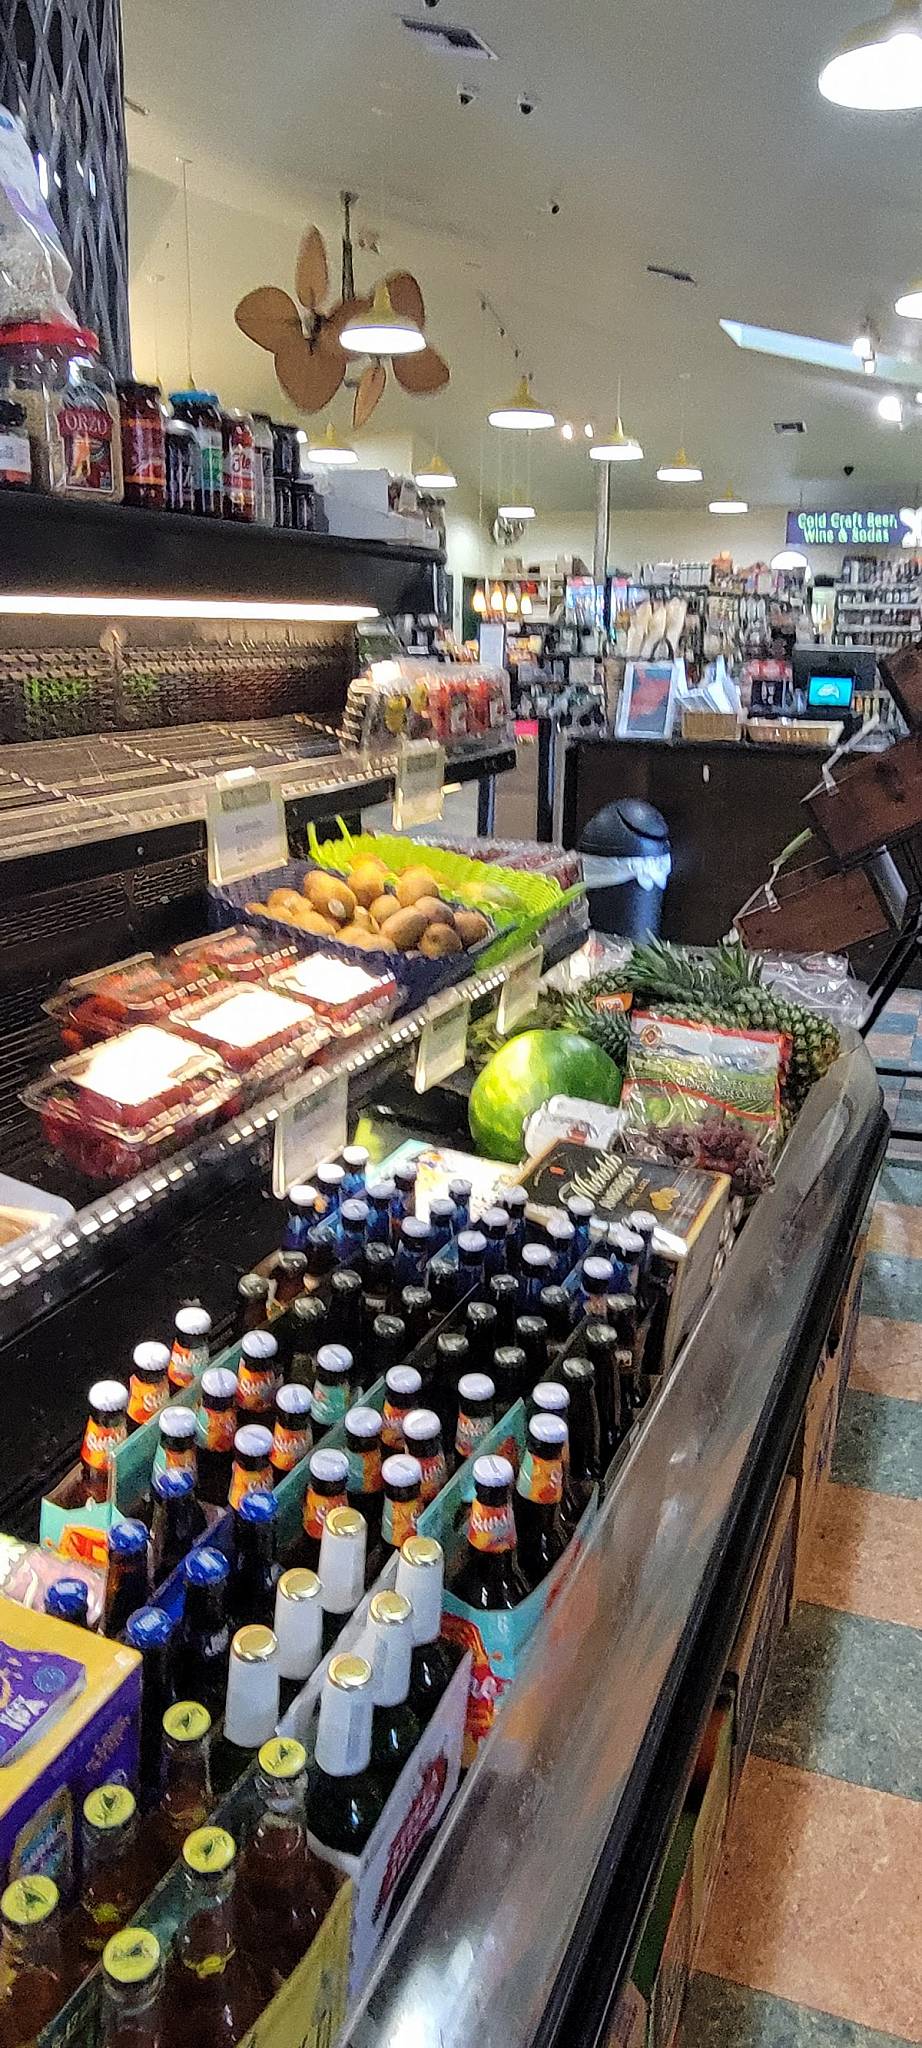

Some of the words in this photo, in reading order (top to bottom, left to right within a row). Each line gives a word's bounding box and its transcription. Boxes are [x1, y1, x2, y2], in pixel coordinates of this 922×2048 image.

[65, 412, 108, 435] ORZO
[798, 512, 827, 529] Cold
[830, 512, 863, 529] Craft
[804, 528, 834, 543] Wine
[838, 528, 848, 543] &
[852, 527, 890, 543] Sodas
